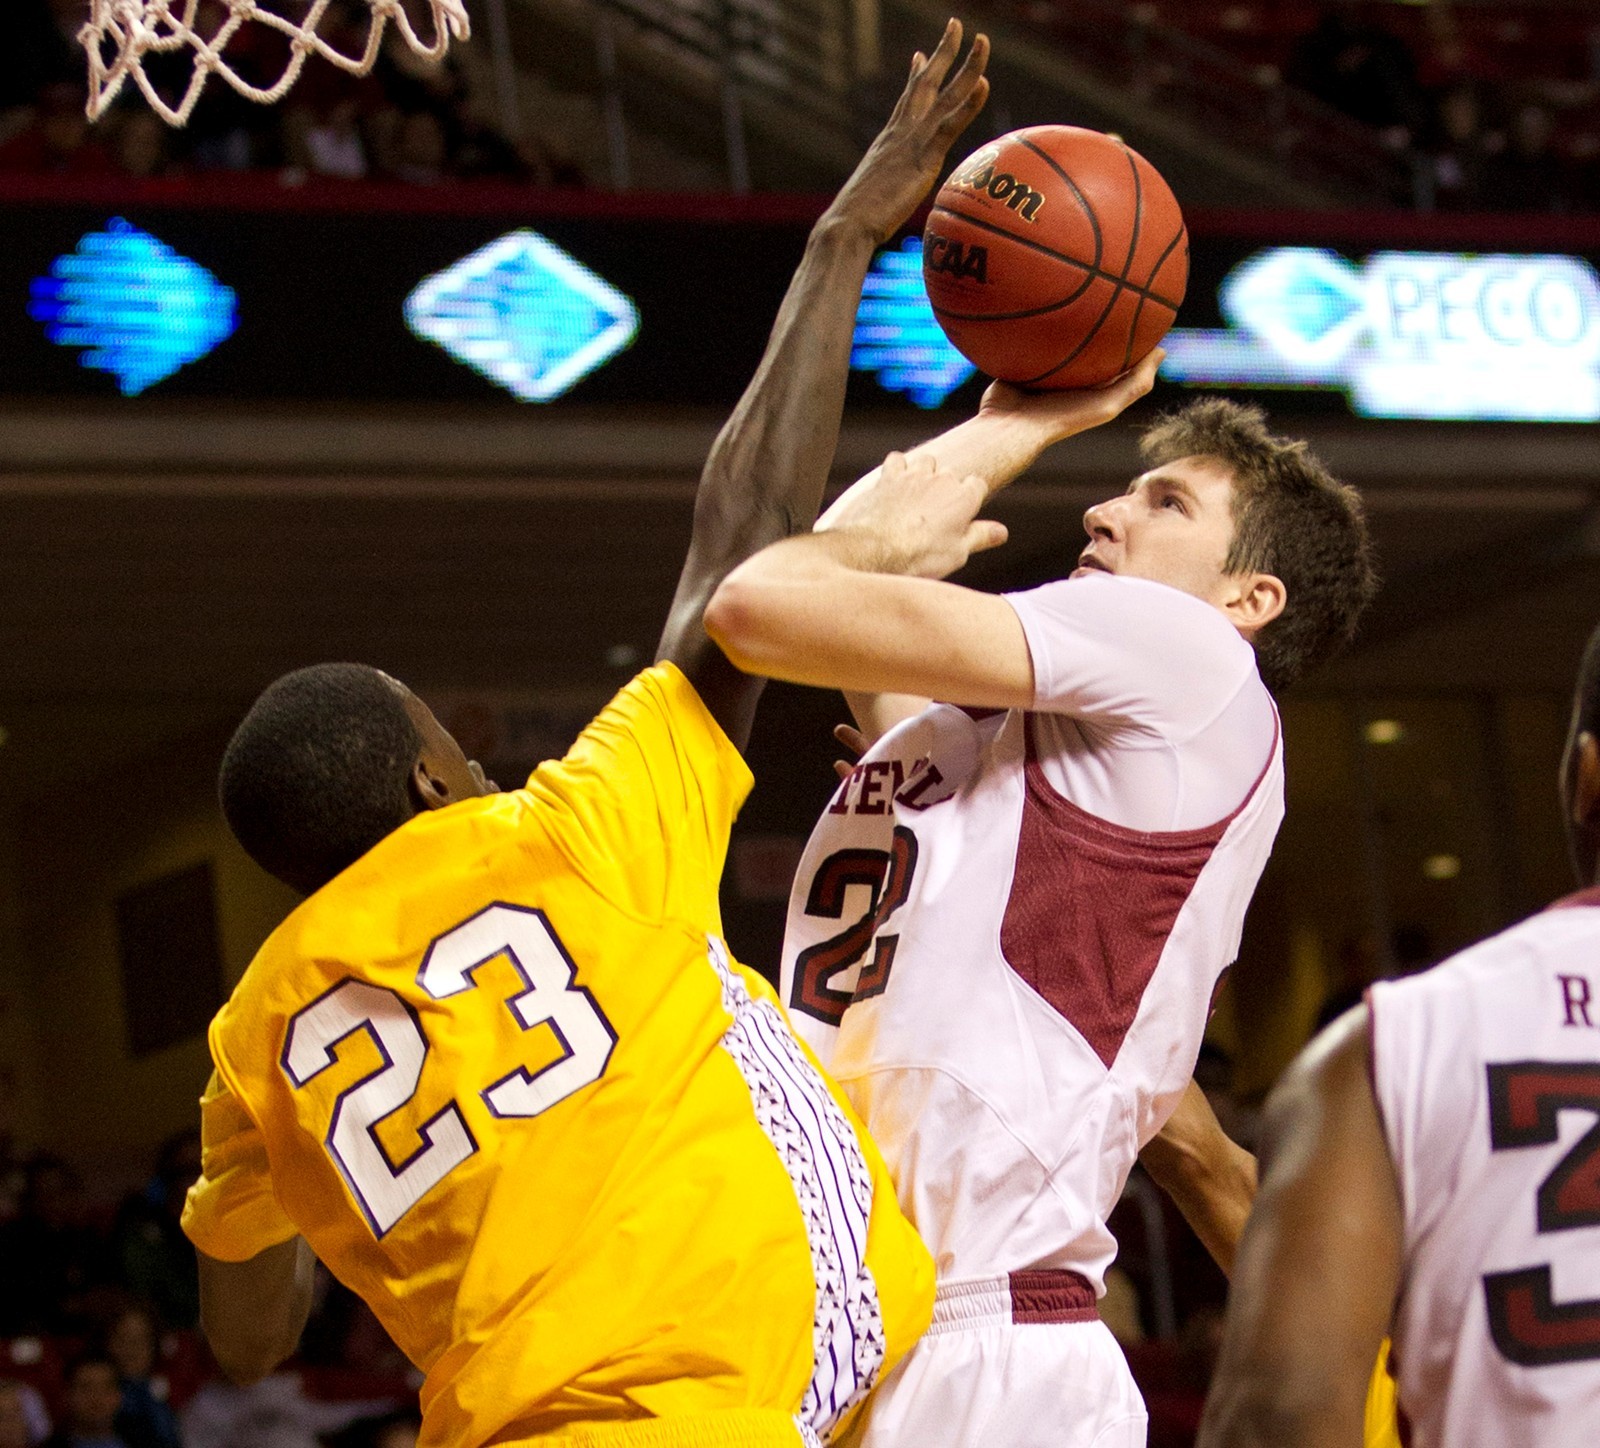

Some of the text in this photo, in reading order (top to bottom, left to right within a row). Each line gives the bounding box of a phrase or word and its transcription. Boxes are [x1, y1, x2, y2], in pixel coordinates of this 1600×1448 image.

[924, 232, 988, 284] CAA
[1385, 271, 1589, 347] PECO
[1556, 973, 1600, 1028] R
[279, 900, 620, 1241] 23
